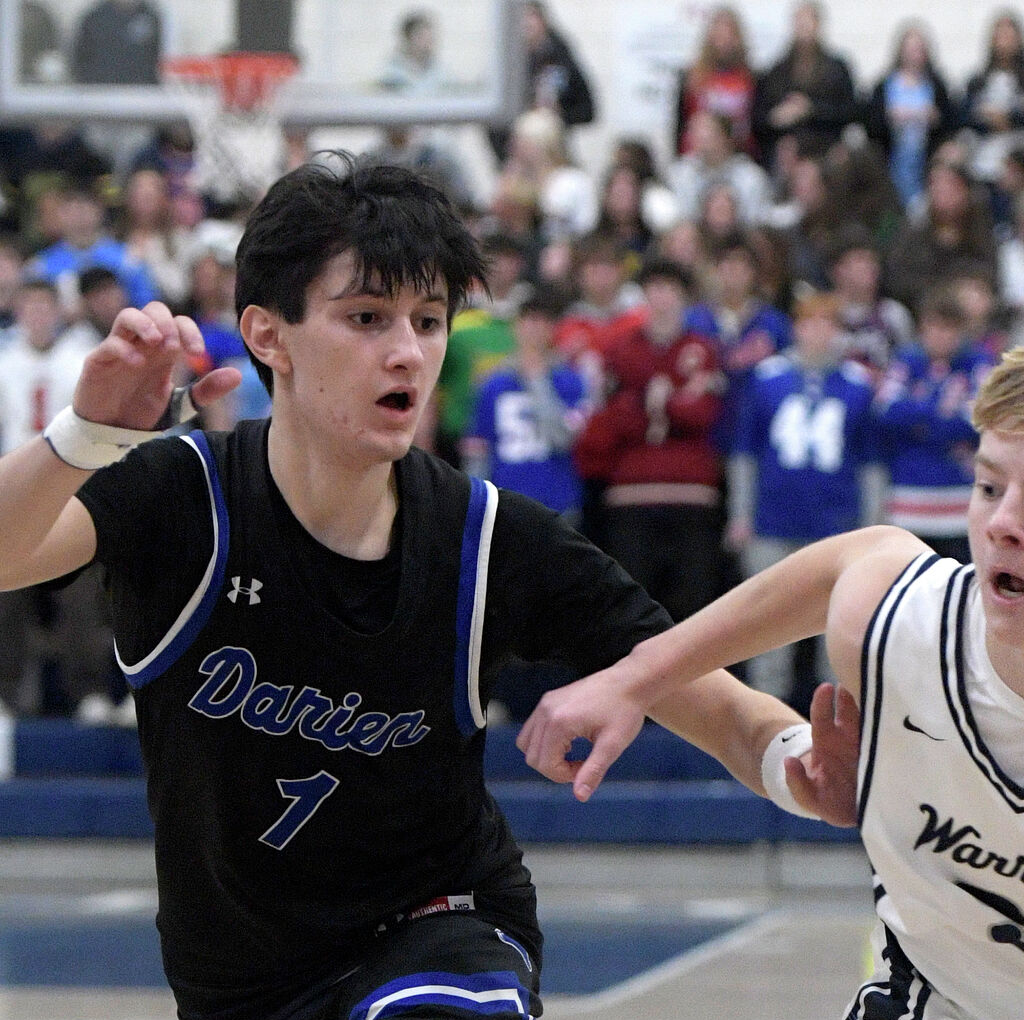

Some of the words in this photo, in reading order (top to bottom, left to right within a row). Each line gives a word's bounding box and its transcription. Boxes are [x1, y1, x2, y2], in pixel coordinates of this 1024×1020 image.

[188, 645, 431, 756] Darien
[258, 769, 340, 850] 1
[411, 903, 447, 919] AUTHENTIC
